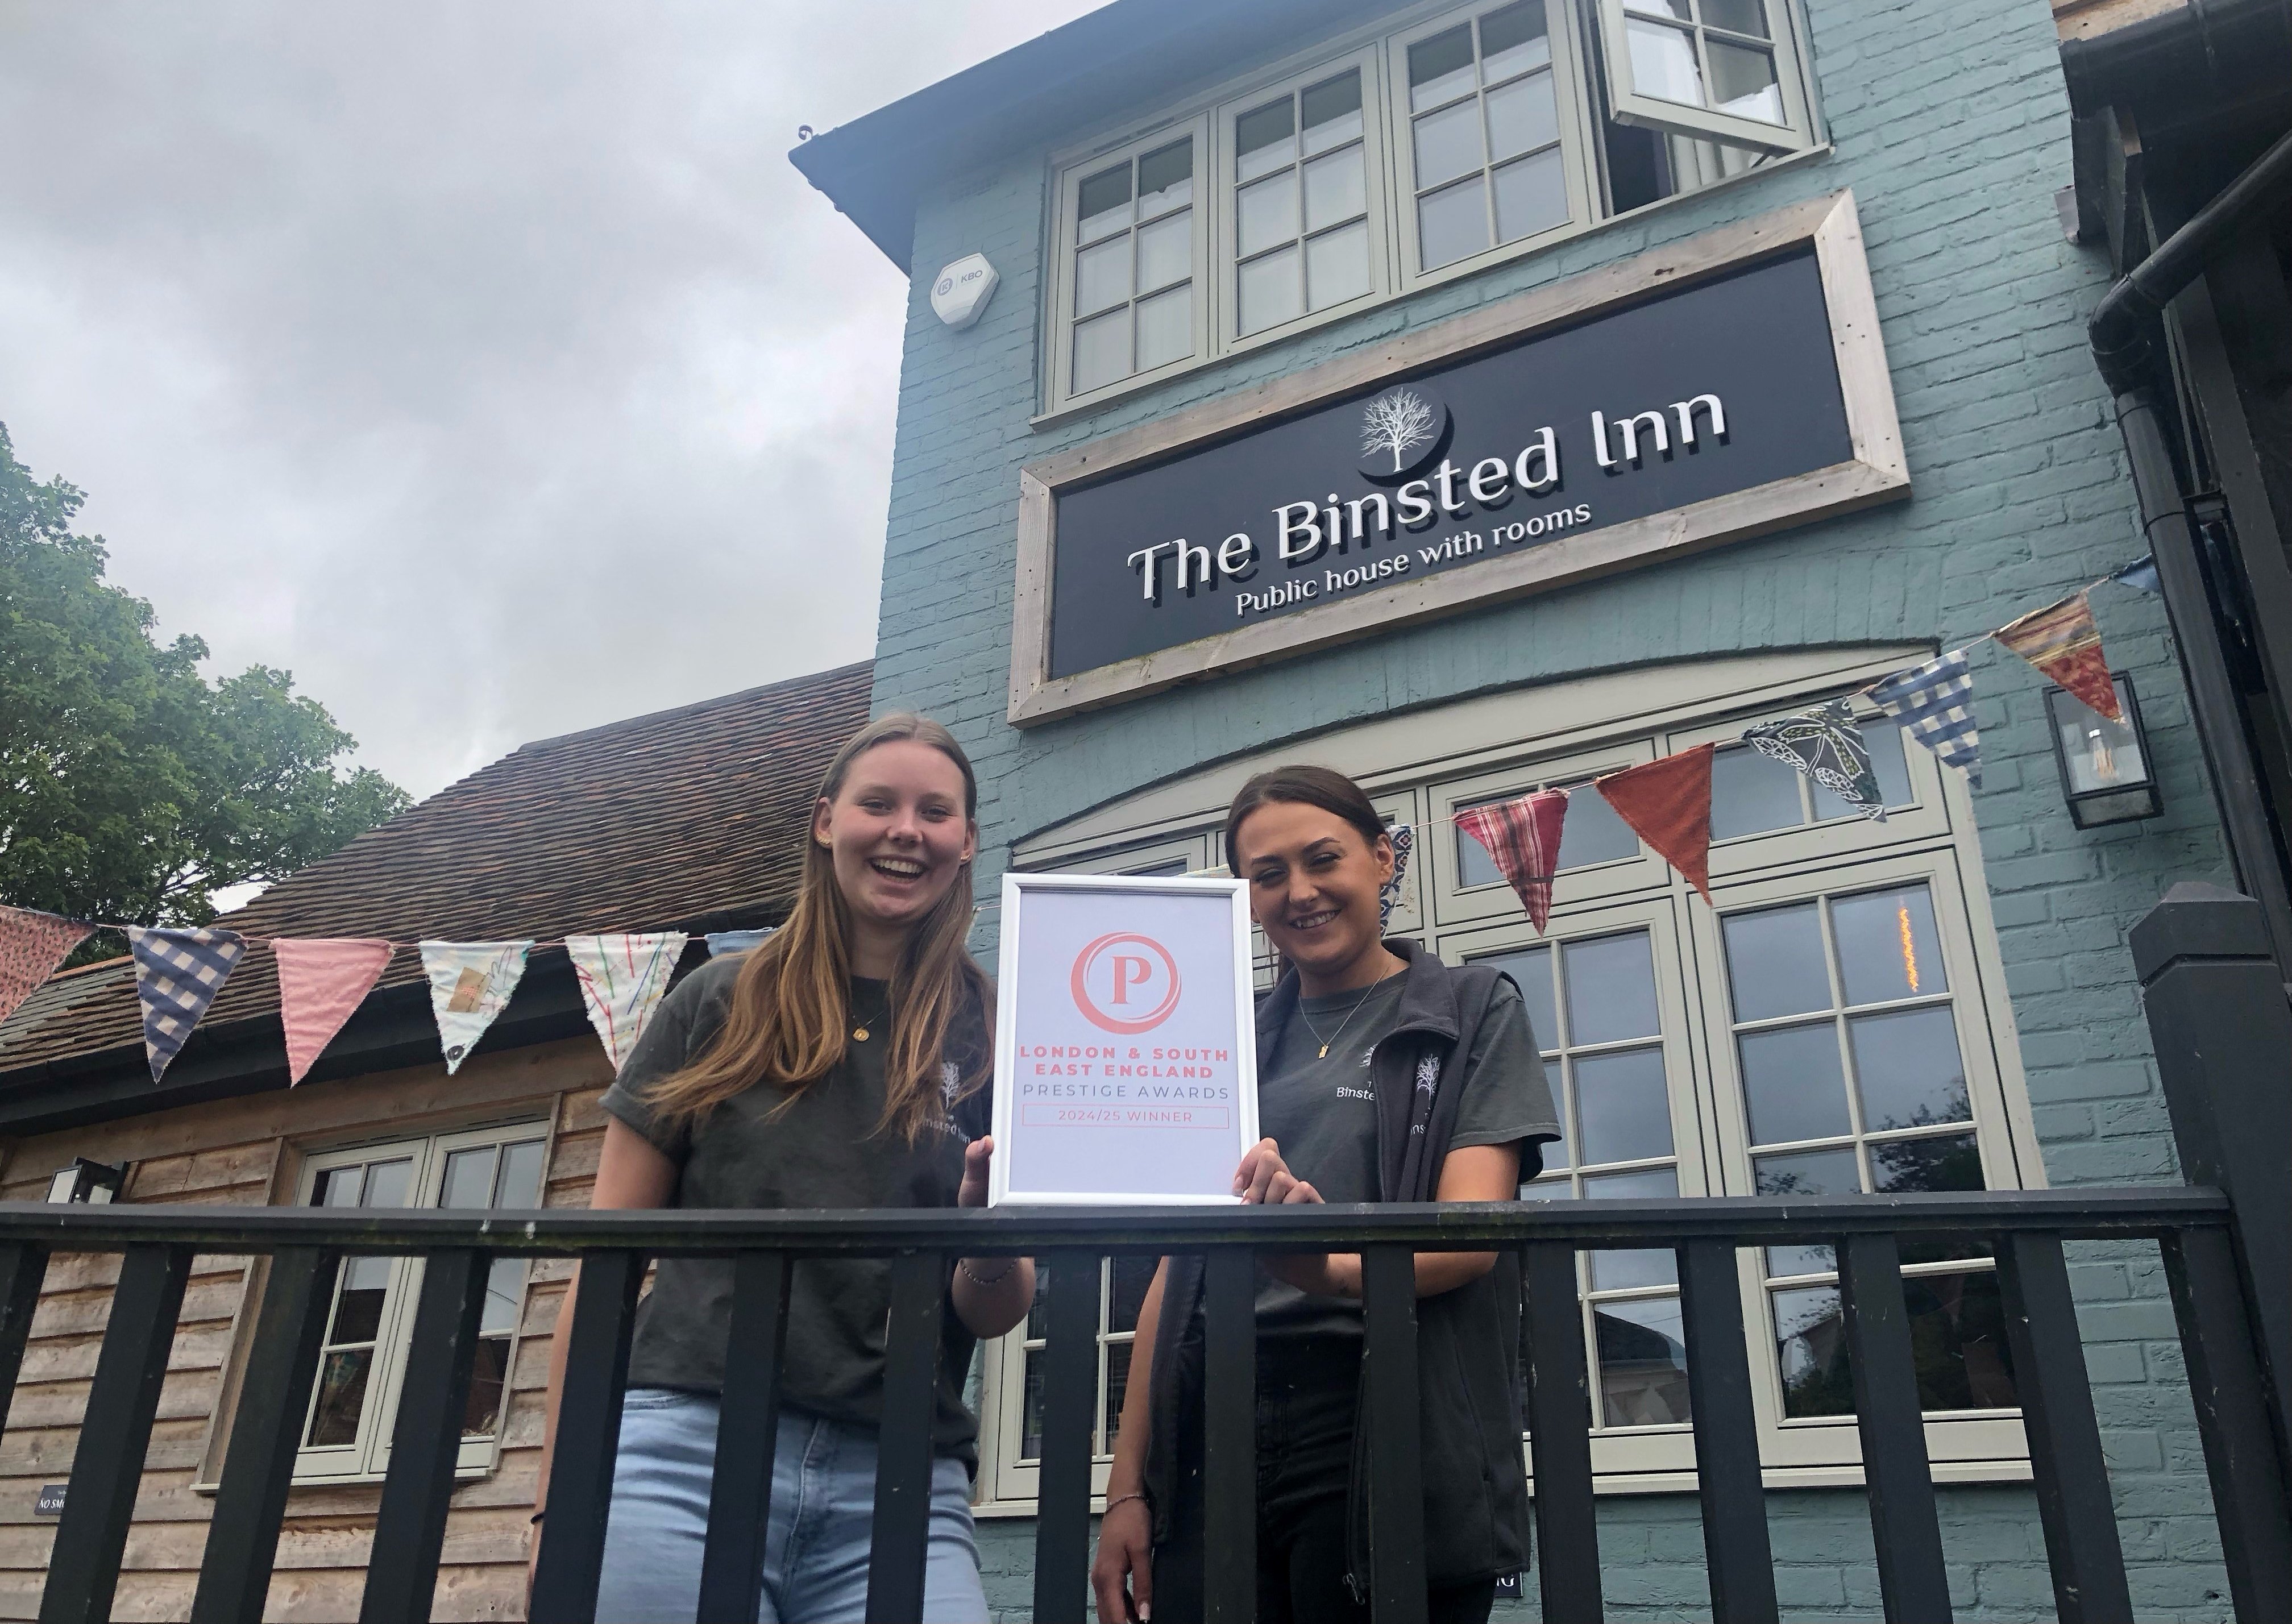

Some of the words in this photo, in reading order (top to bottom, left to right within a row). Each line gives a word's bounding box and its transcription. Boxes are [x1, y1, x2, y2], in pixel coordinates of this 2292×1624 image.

[961, 270, 983, 283] KBO
[1127, 533, 1251, 600] The
[1272, 426, 1558, 559] Binsted
[1591, 393, 1725, 467] Inn
[1235, 578, 1317, 616] Public
[1324, 554, 1409, 592] house
[1417, 531, 1483, 565] with
[1491, 504, 1591, 546] rooms
[1020, 1045, 1115, 1058] LONDON
[1128, 1047, 1140, 1059] &
[1153, 1048, 1228, 1062] SOUTH
[1035, 1063, 1091, 1076] EAST
[1105, 1064, 1213, 1078] ENGLAND
[1023, 1084, 1127, 1098] PRESTIGE
[1138, 1086, 1228, 1099] AWARDS
[1336, 1086, 1375, 1101] Binste
[1058, 1109, 1120, 1122] 2024/25
[1127, 1111, 1192, 1123] WINNER
